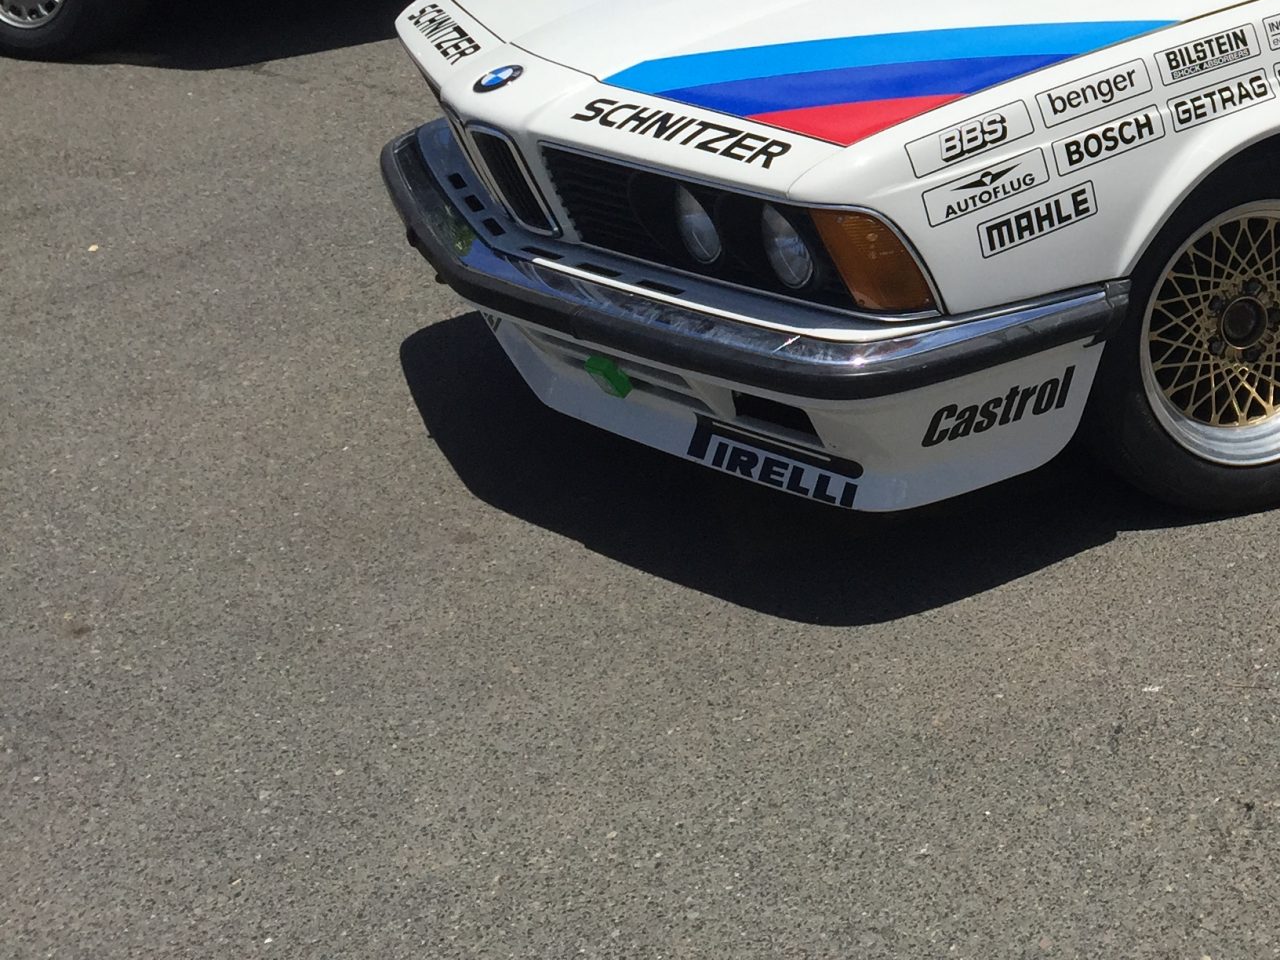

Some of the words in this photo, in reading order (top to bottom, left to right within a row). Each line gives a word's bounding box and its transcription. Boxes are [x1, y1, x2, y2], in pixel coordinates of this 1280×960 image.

[407, 3, 482, 66] SCHNITZER
[1165, 28, 1249, 71] BILSTEIN
[1172, 65, 1201, 80] SHOCK
[1202, 48, 1250, 68] ABSORBERS
[1047, 68, 1137, 115] benger
[1174, 75, 1269, 126] GETRAG
[570, 98, 793, 170] SCHNITZER
[938, 112, 1008, 163] BBS
[1064, 113, 1155, 167] BOSCH
[944, 173, 1036, 219] AUTOFLUG
[985, 188, 1091, 252] MAHLE
[921, 365, 1077, 448] Castrol
[686, 410, 865, 510] PIRELLI
